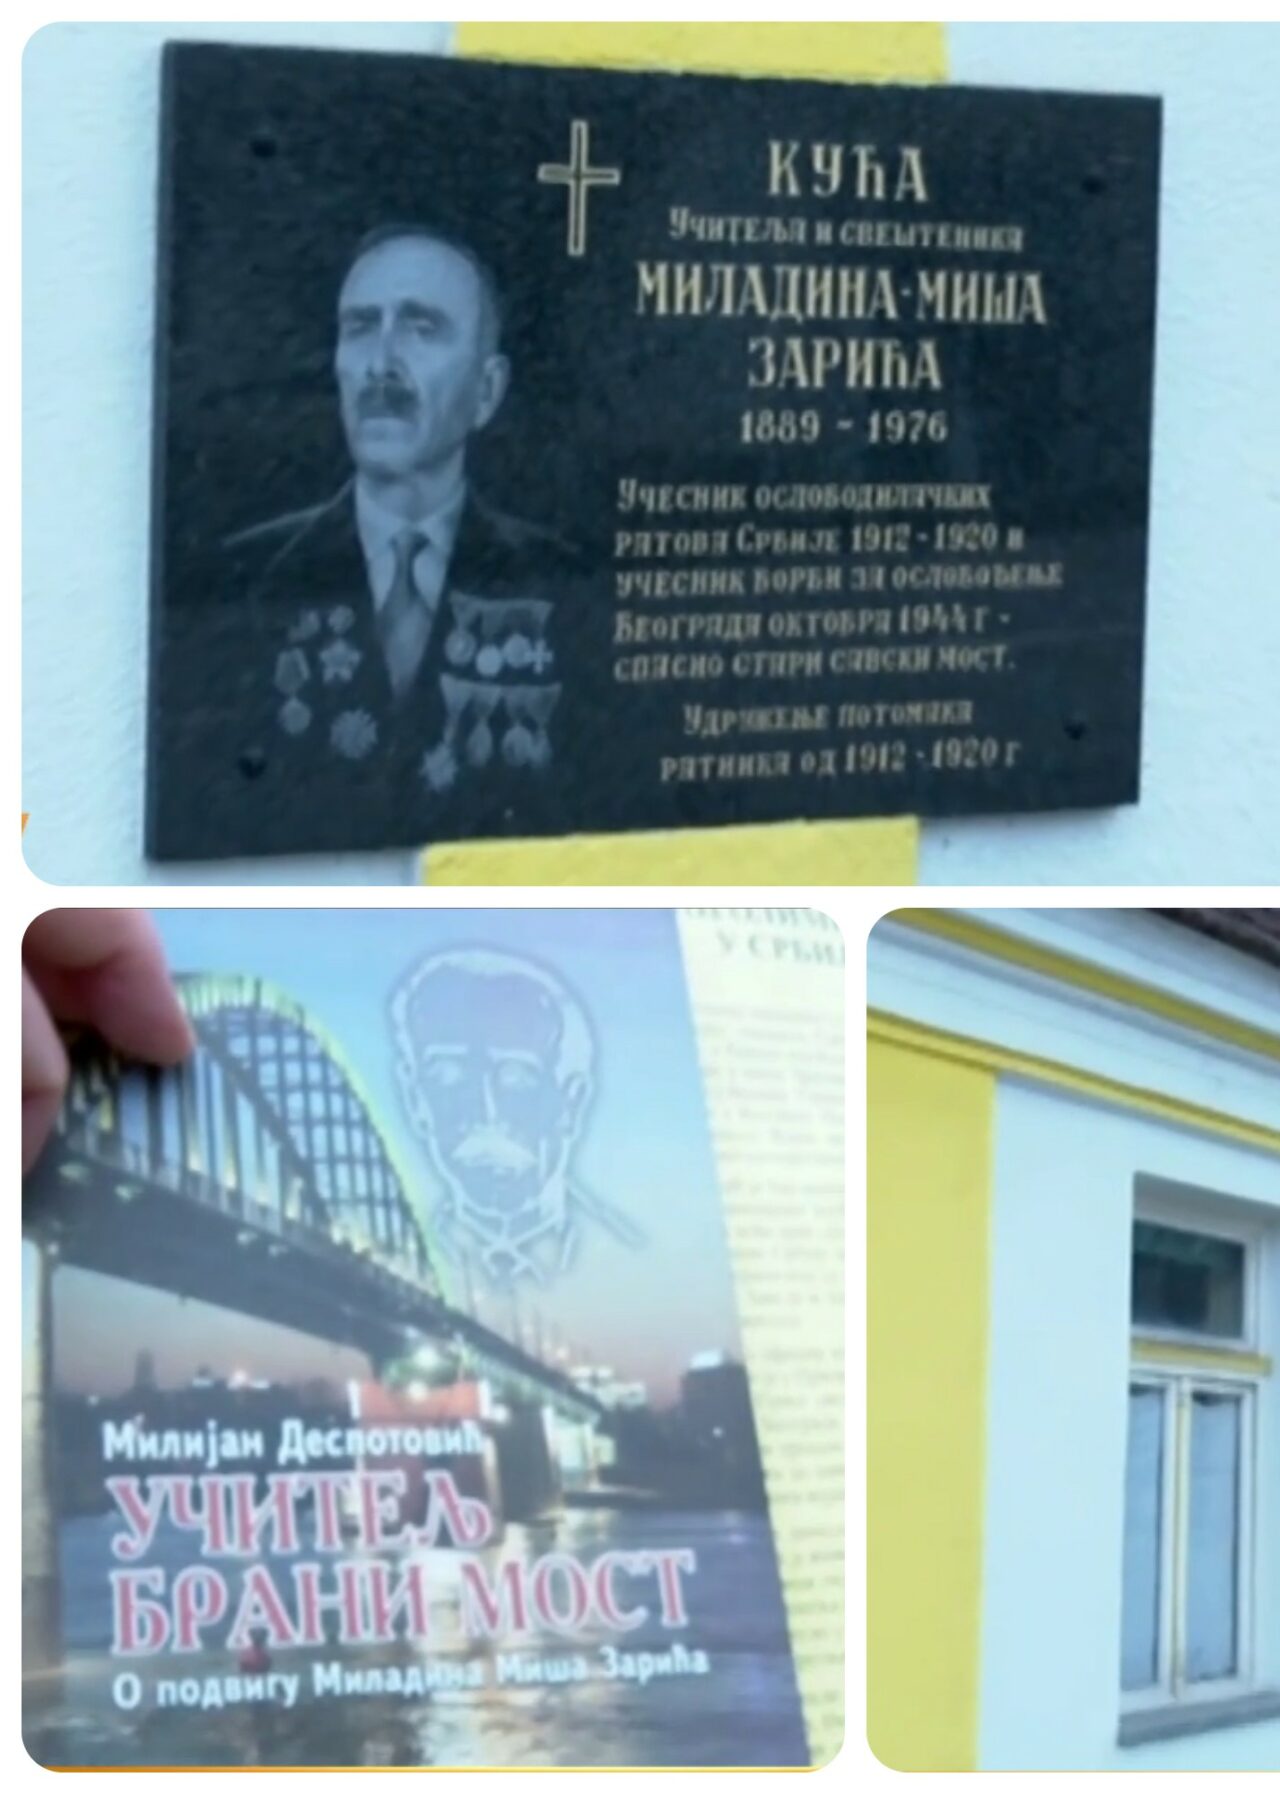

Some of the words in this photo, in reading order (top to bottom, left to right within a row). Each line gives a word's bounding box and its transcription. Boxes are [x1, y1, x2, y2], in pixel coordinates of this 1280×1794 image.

[768, 140, 929, 201] КУЋА
[748, 337, 942, 391] ЗАРИЋА
[740, 409, 821, 443] 1889
[868, 410, 947, 443] 1976
[103, 1420, 264, 1468] Милијан
[278, 1417, 484, 1465] Деспотовић
[104, 1469, 493, 1560] УЧИТЕЉ
[108, 1559, 432, 1657] БРАНИ
[461, 1549, 697, 1640] МОСТ
[113, 1674, 141, 1710] О
[157, 1670, 299, 1708] подвигу
[313, 1660, 484, 1697] Миладина
[497, 1653, 588, 1687] Миша
[602, 1645, 709, 1681] Зарића
